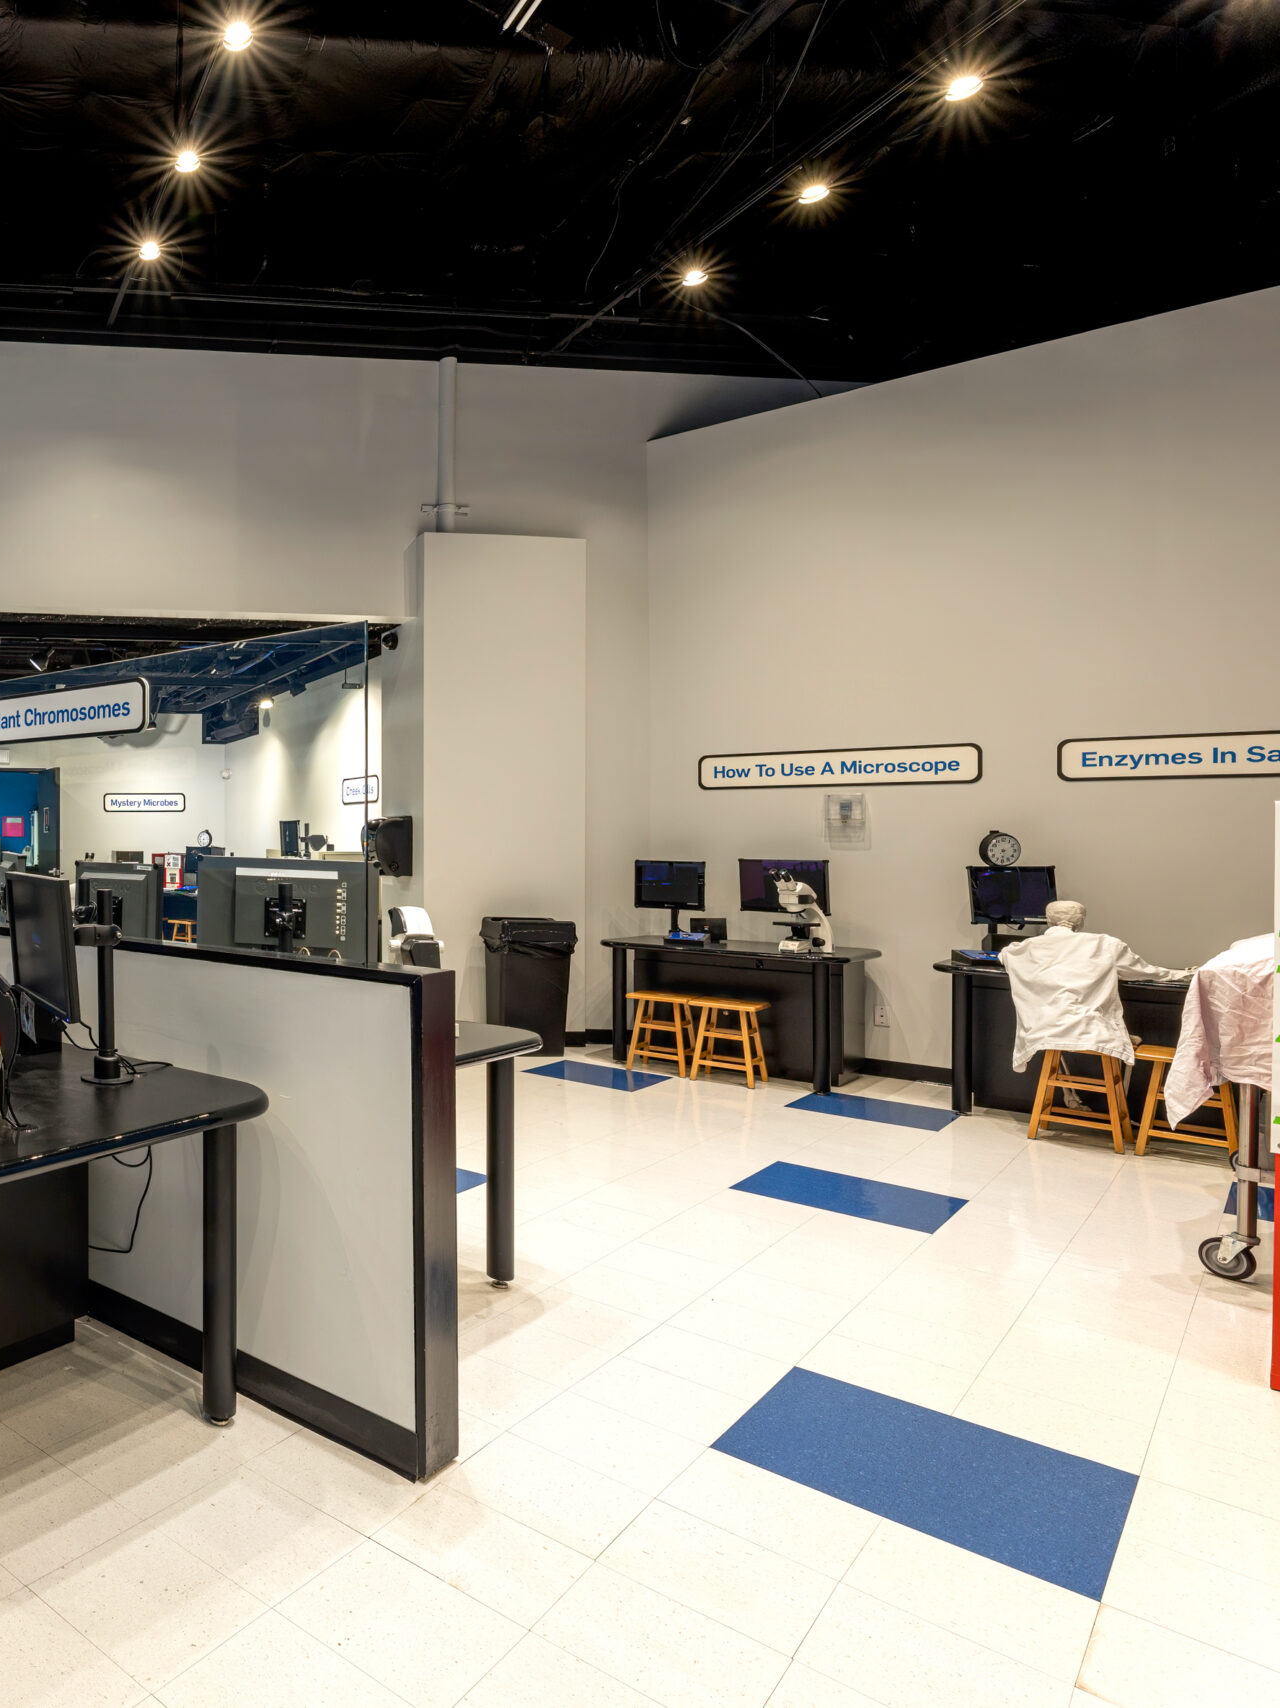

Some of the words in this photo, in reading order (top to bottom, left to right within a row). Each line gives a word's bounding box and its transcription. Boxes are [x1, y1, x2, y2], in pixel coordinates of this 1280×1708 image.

[24, 701, 131, 727] Chromosomes
[1081, 751, 1203, 770] Enzymes
[1213, 747, 1237, 764] In
[713, 765, 751, 779] How
[755, 763, 775, 777] To
[780, 763, 815, 776] Use
[820, 761, 835, 775] A
[840, 760, 960, 775] Microscope
[109, 798, 141, 808] Mystery
[143, 798, 178, 807] Microbes
